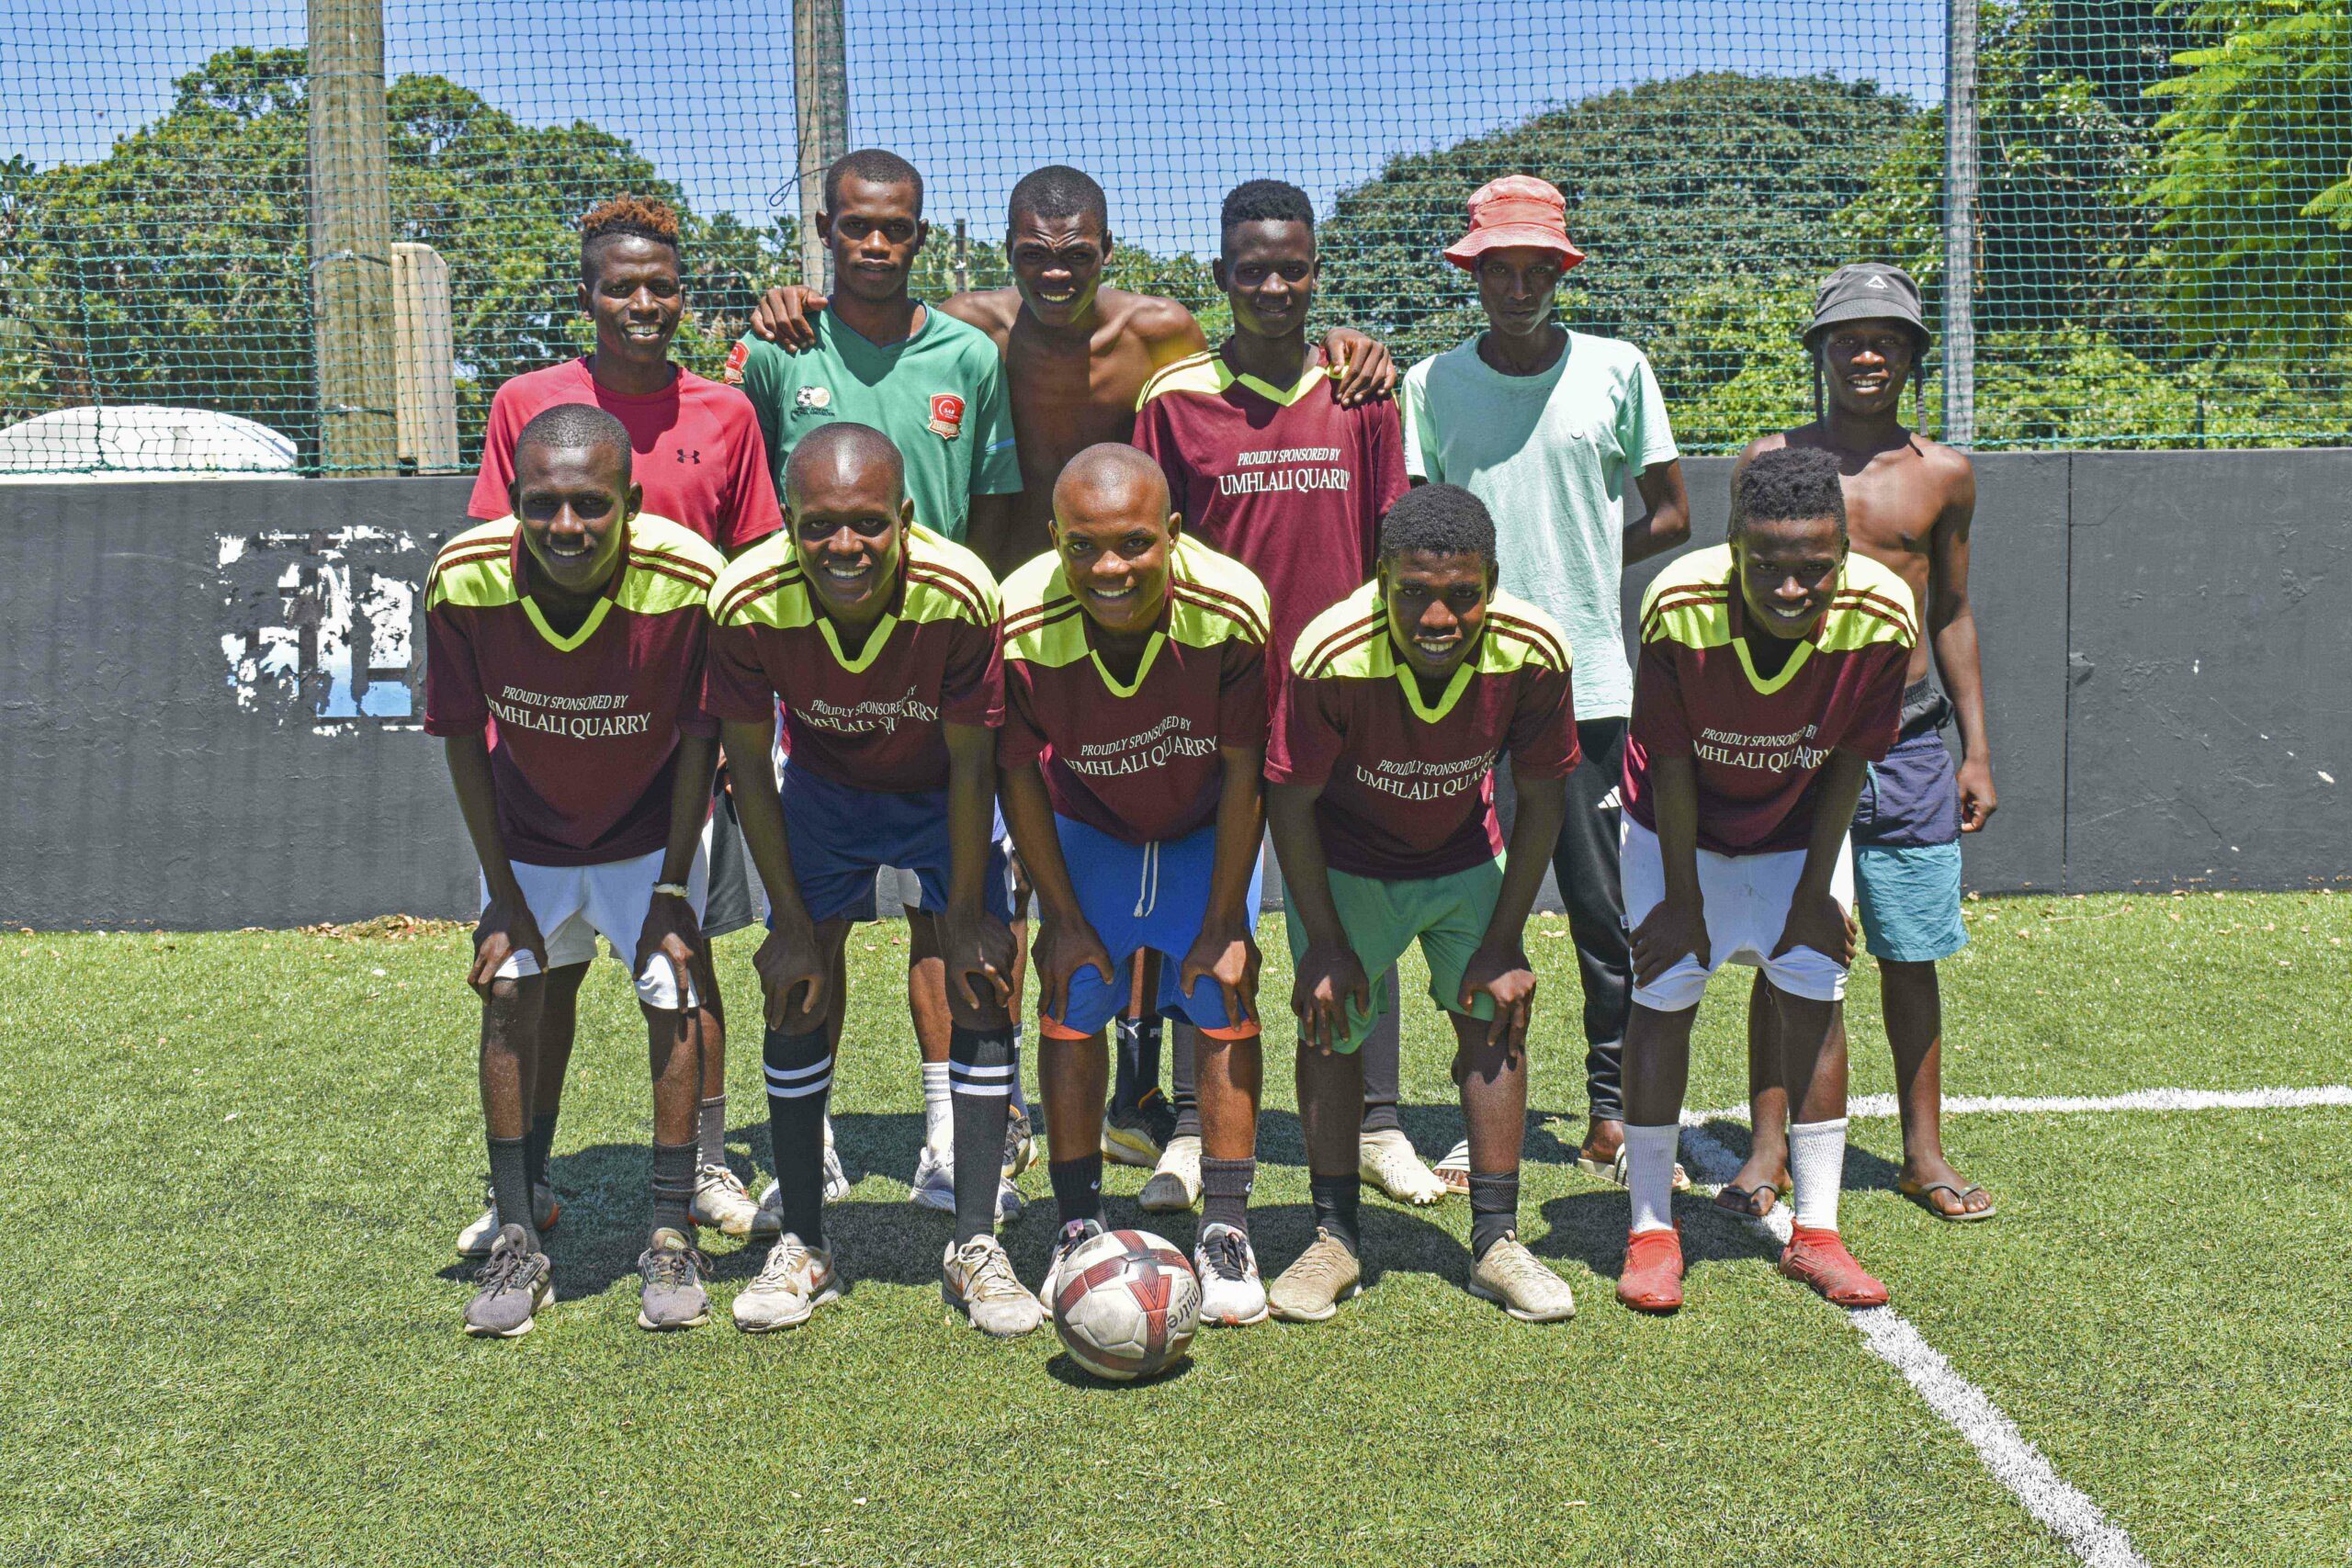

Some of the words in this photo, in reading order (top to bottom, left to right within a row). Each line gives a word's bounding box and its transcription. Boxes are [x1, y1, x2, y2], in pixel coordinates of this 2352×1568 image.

[1238, 450, 1279, 467] PROUDLY
[1278, 447, 1329, 463] SPONSORED
[1329, 448, 1341, 462] BY
[1219, 469, 1293, 496] UMHLALI
[1295, 468, 1351, 493] QUARRY
[502, 685, 551, 707] PROUDLY
[550, 694, 612, 711] SPONSORED
[613, 694, 628, 709] BY
[810, 699, 854, 718] PROUDLY
[570, 712, 651, 739] QUARRY
[1080, 739, 1128, 756] PROUDLY
[1128, 716, 1179, 750] SPONSORED
[1180, 717, 1192, 731] BY
[1702, 728, 1751, 747] PROUDLY
[1750, 727, 1806, 747] SPONSORED
[1805, 724, 1818, 739] BY
[1061, 751, 1149, 776] UMHLALI
[1150, 735, 1218, 767] QUARRY
[1375, 759, 1424, 776] PROUDLY
[1423, 755, 1482, 776] SPONSORED
[1692, 739, 1765, 770] MHLALI
[1768, 745, 1835, 773] QUARRY
[1356, 764, 1440, 801] UMHLALI
[1442, 755, 1497, 797] QUARR
[1167, 1286, 1198, 1329] mitre
